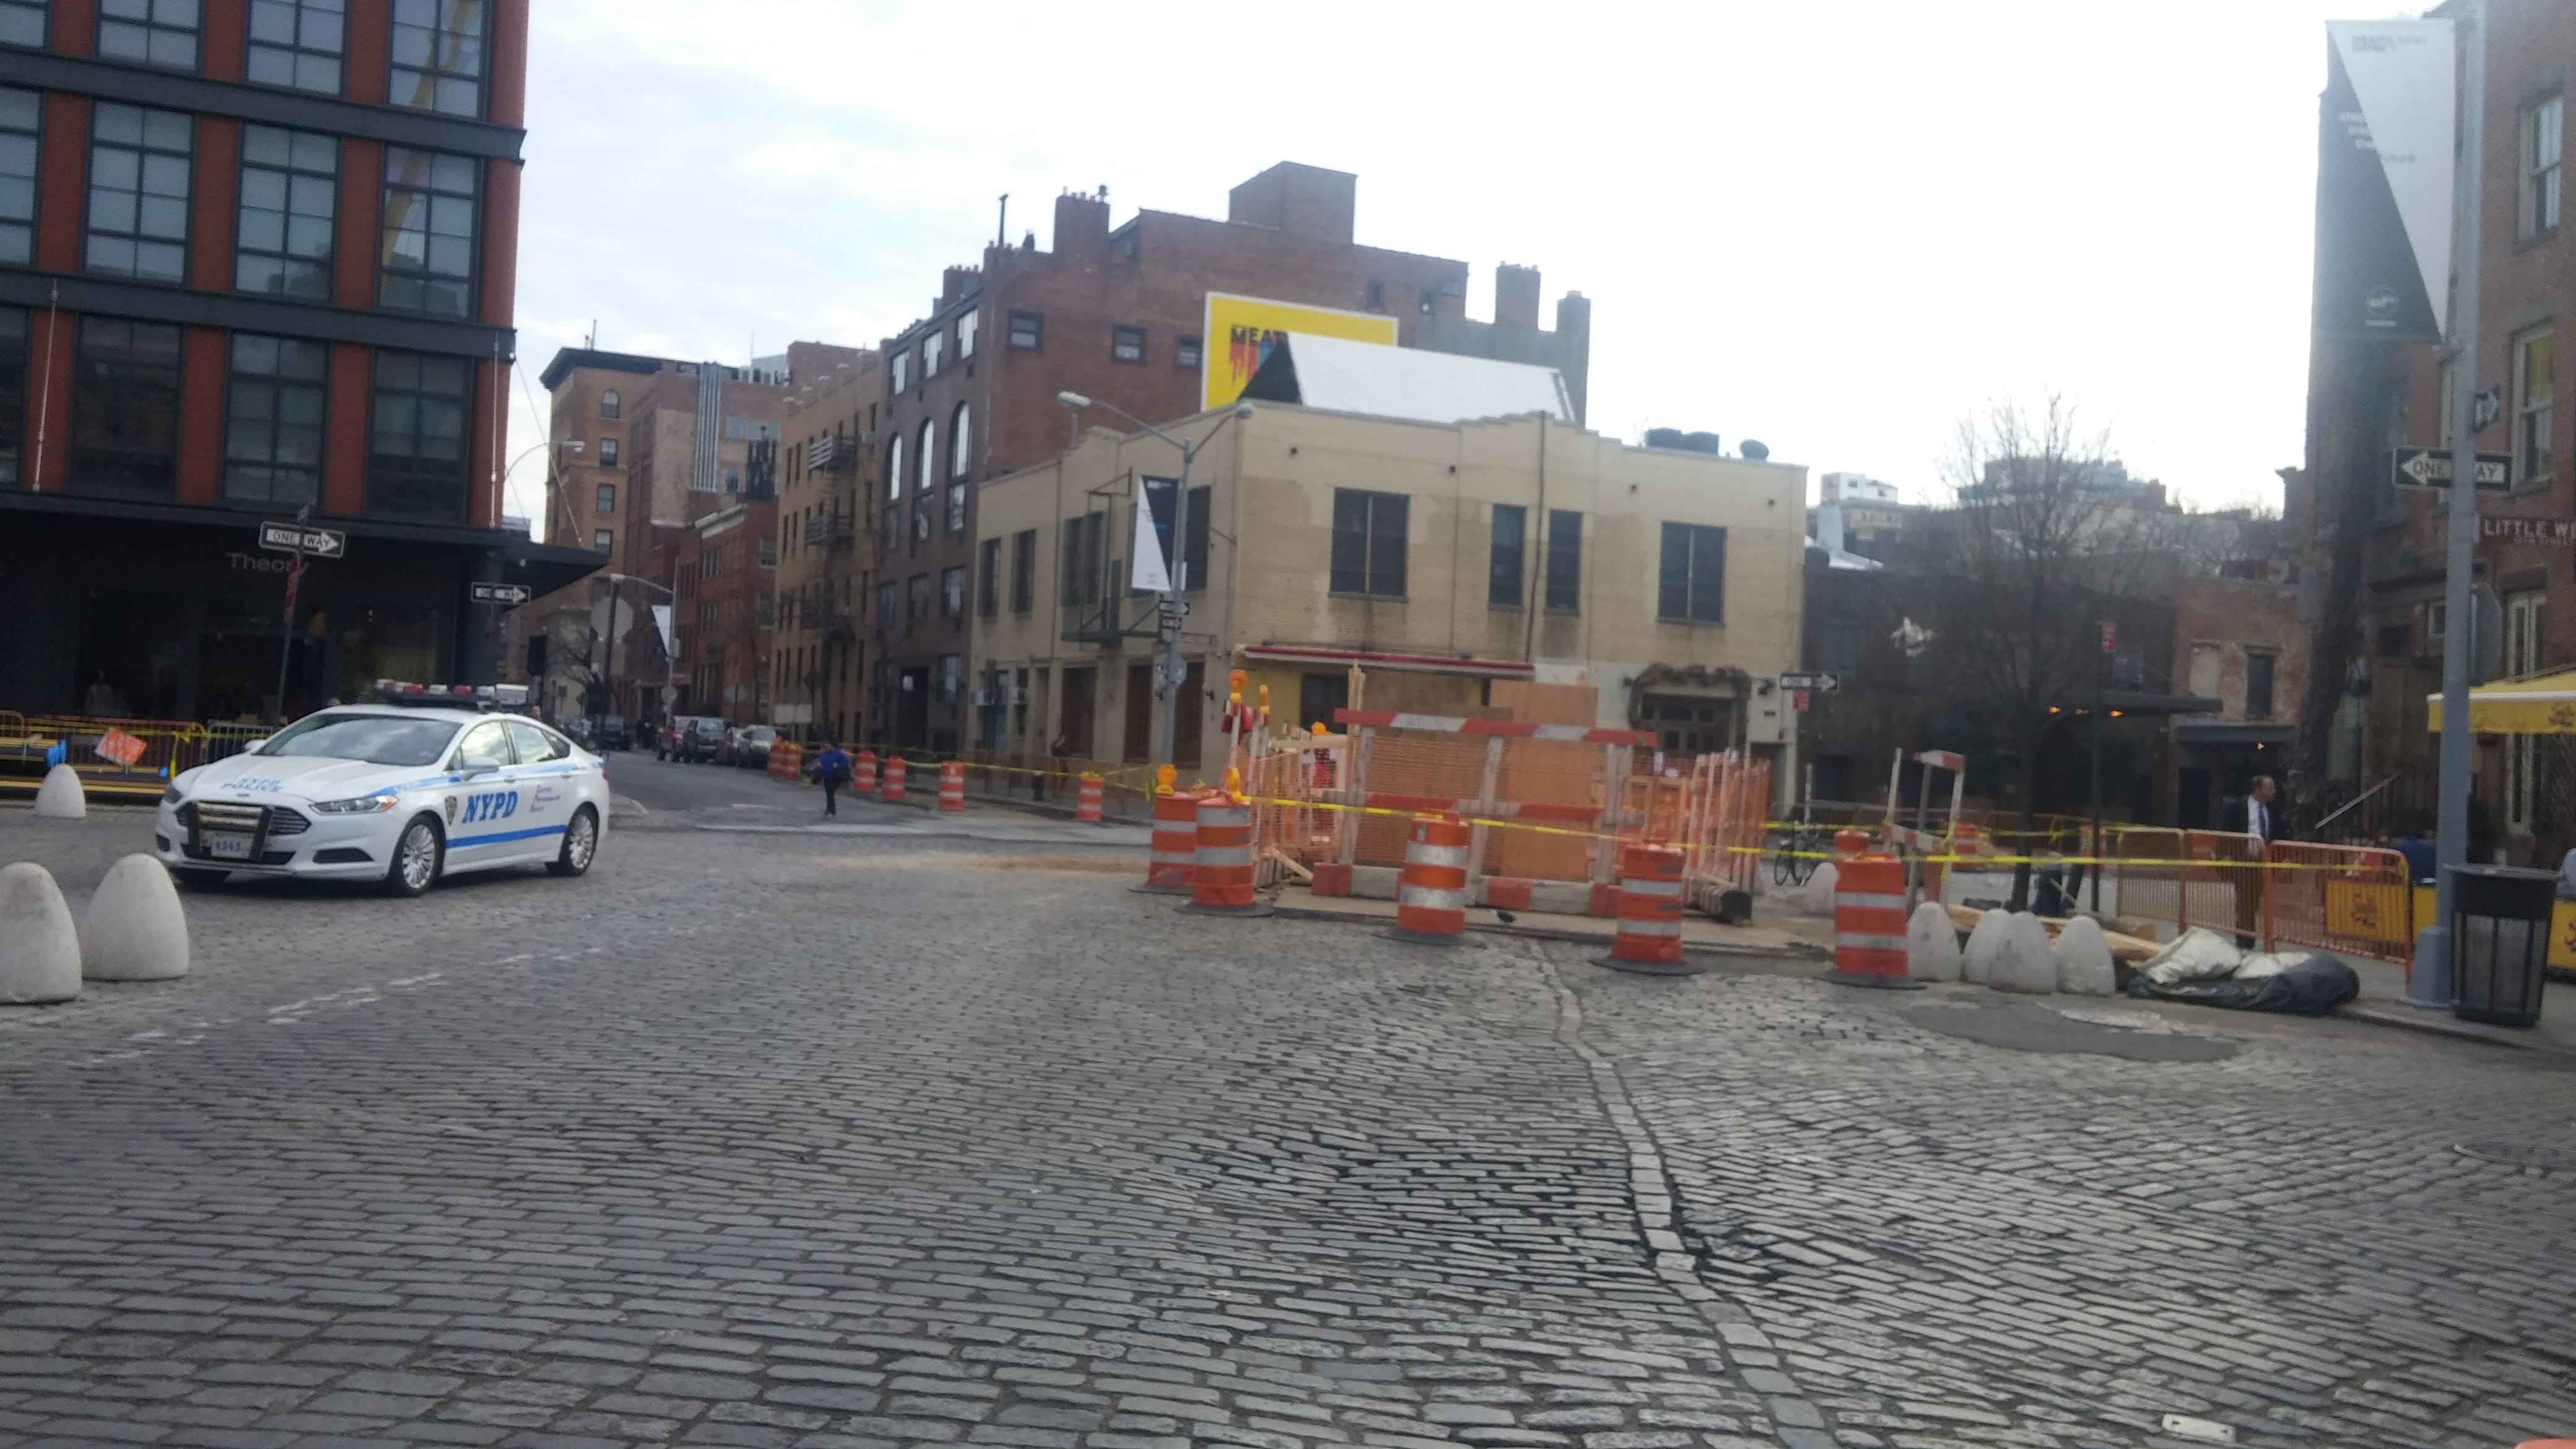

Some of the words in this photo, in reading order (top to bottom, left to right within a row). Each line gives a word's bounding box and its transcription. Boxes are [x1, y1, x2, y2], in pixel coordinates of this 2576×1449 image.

[2484, 519, 2547, 537] LITTLE
[273, 531, 296, 545] ONE
[307, 536, 332, 548] WAY
[462, 791, 518, 824] NYPD
